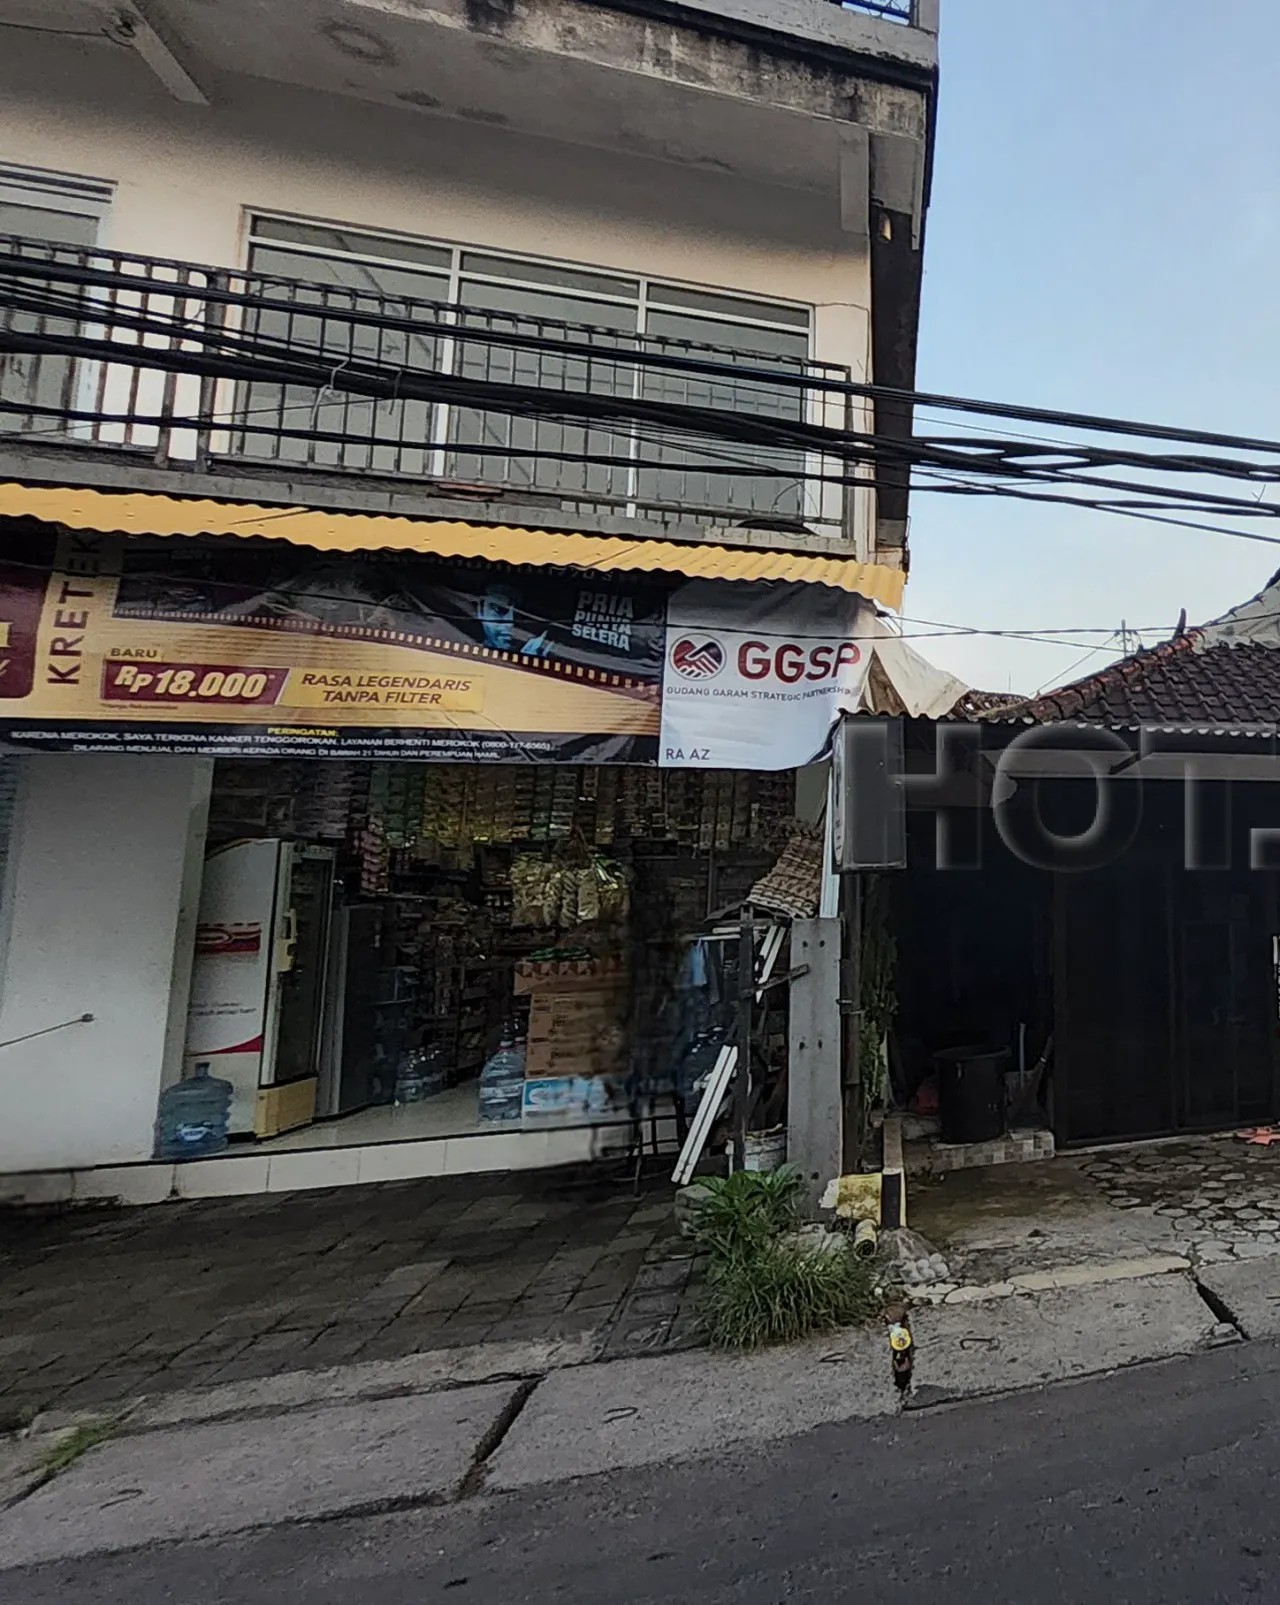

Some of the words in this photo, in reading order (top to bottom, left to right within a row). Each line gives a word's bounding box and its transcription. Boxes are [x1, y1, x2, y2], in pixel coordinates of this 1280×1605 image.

[47, 532, 102, 685] KRETEK
[577, 589, 634, 618] PRIA
[574, 609, 632, 636] PUNYA
[572, 623, 630, 652] SELERA
[110, 648, 157, 658] BARU
[738, 640, 861, 684] GGSP
[114, 665, 267, 698] Rp18.000
[301, 673, 352, 687] RASA
[357, 675, 472, 691] LEGENDARIS
[323, 690, 380, 703] TANPA
[385, 692, 442, 704] FILTER
[666, 686, 710, 696] GUDANG
[712, 688, 749, 699] GARAM
[750, 690, 801, 701] STRATEGIC
[155, 733, 207, 742] TERKENA
[209, 735, 252, 743] KANKER
[341, 738, 382, 746] LAYANAN
[383, 738, 430, 747] BERHENTI
[431, 739, 480, 748] MEROKOK
[73, 744, 125, 752] DILARANG
[174, 746, 196, 754] DAN
[281, 747, 317, 756] ORANG
[318, 749, 329, 757] DI
[401, 749, 419, 758] DAN
[420, 750, 473, 758] PEREMPUAN
[666, 748, 685, 761] RA
[689, 748, 711, 761] AZ
